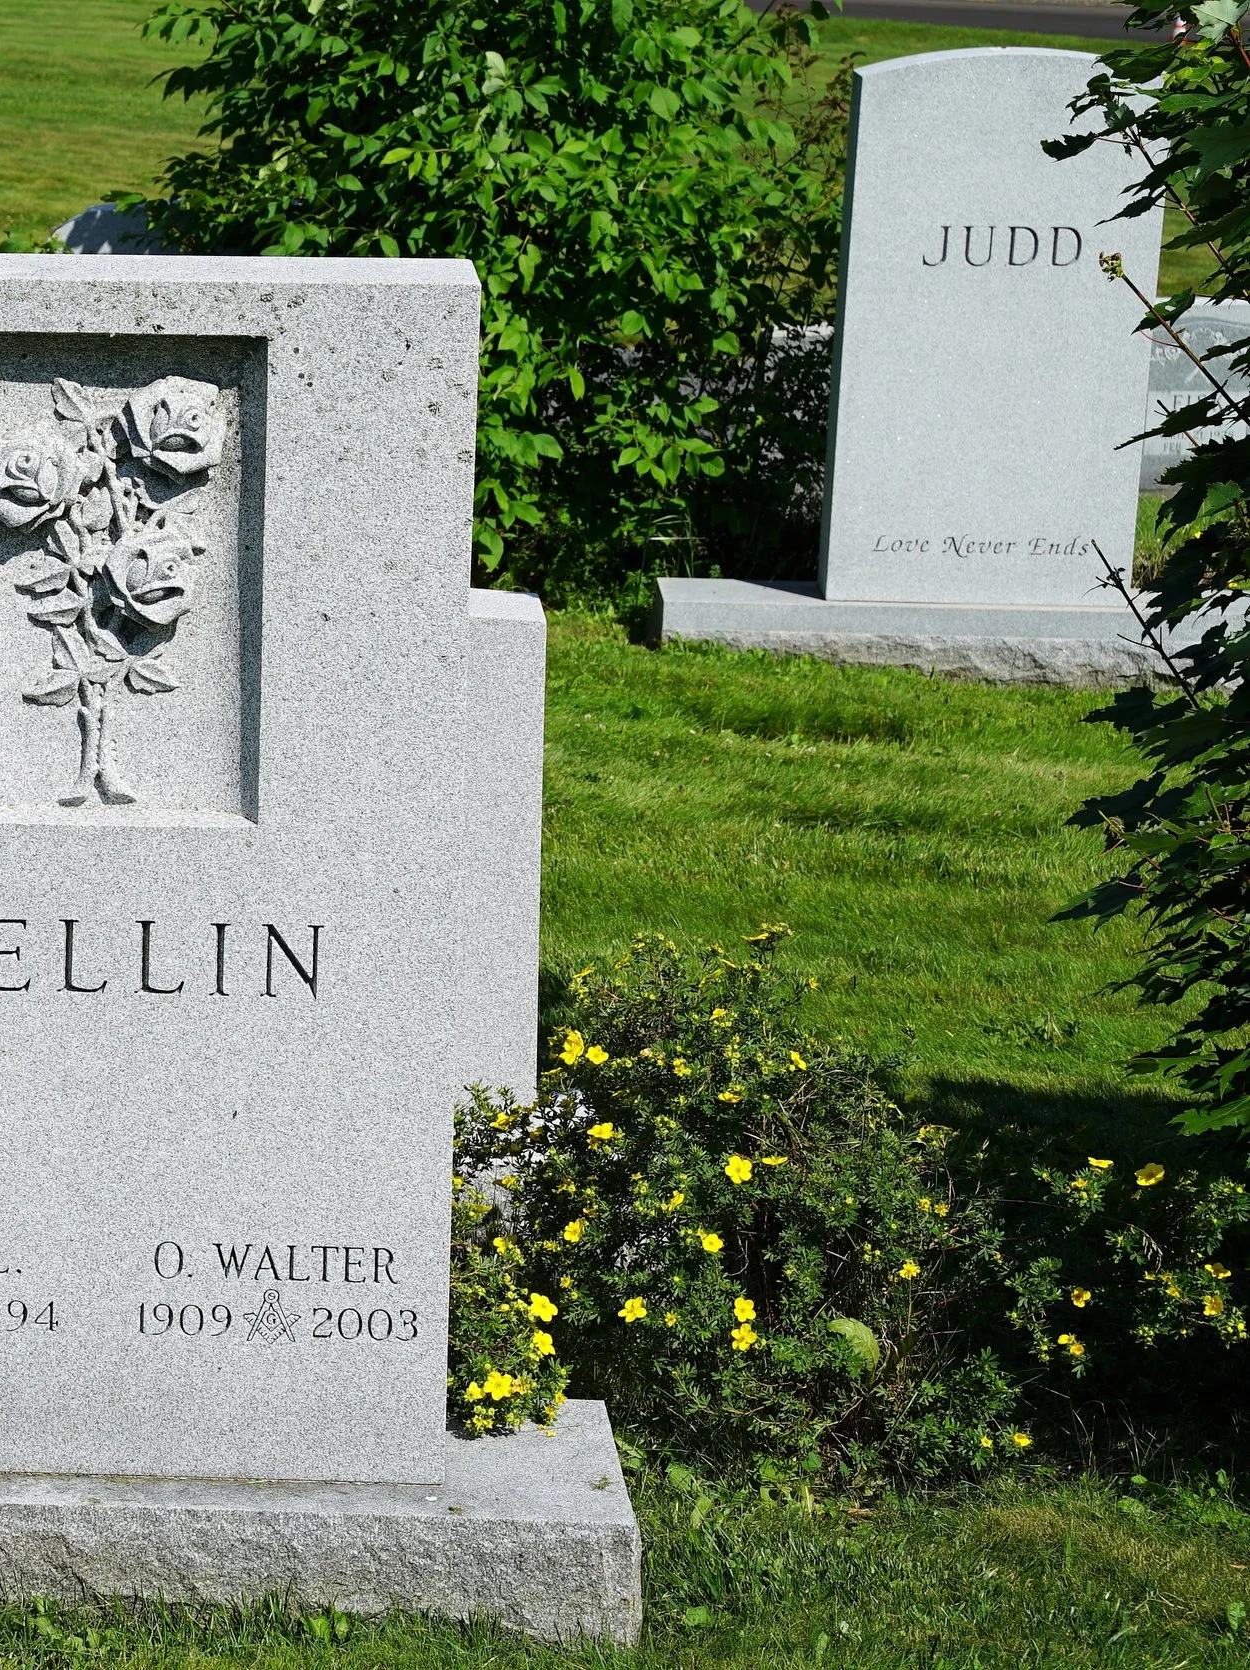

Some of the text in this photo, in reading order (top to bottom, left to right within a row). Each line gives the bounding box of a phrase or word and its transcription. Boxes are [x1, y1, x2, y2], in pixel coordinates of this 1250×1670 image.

[922, 225, 1083, 267] JUDD
[872, 533, 1088, 558] Love Never Ends
[153, 1241, 399, 1285] O. WALTER
[137, 1302, 233, 1338] 1909
[311, 1306, 419, 1341] 2003
